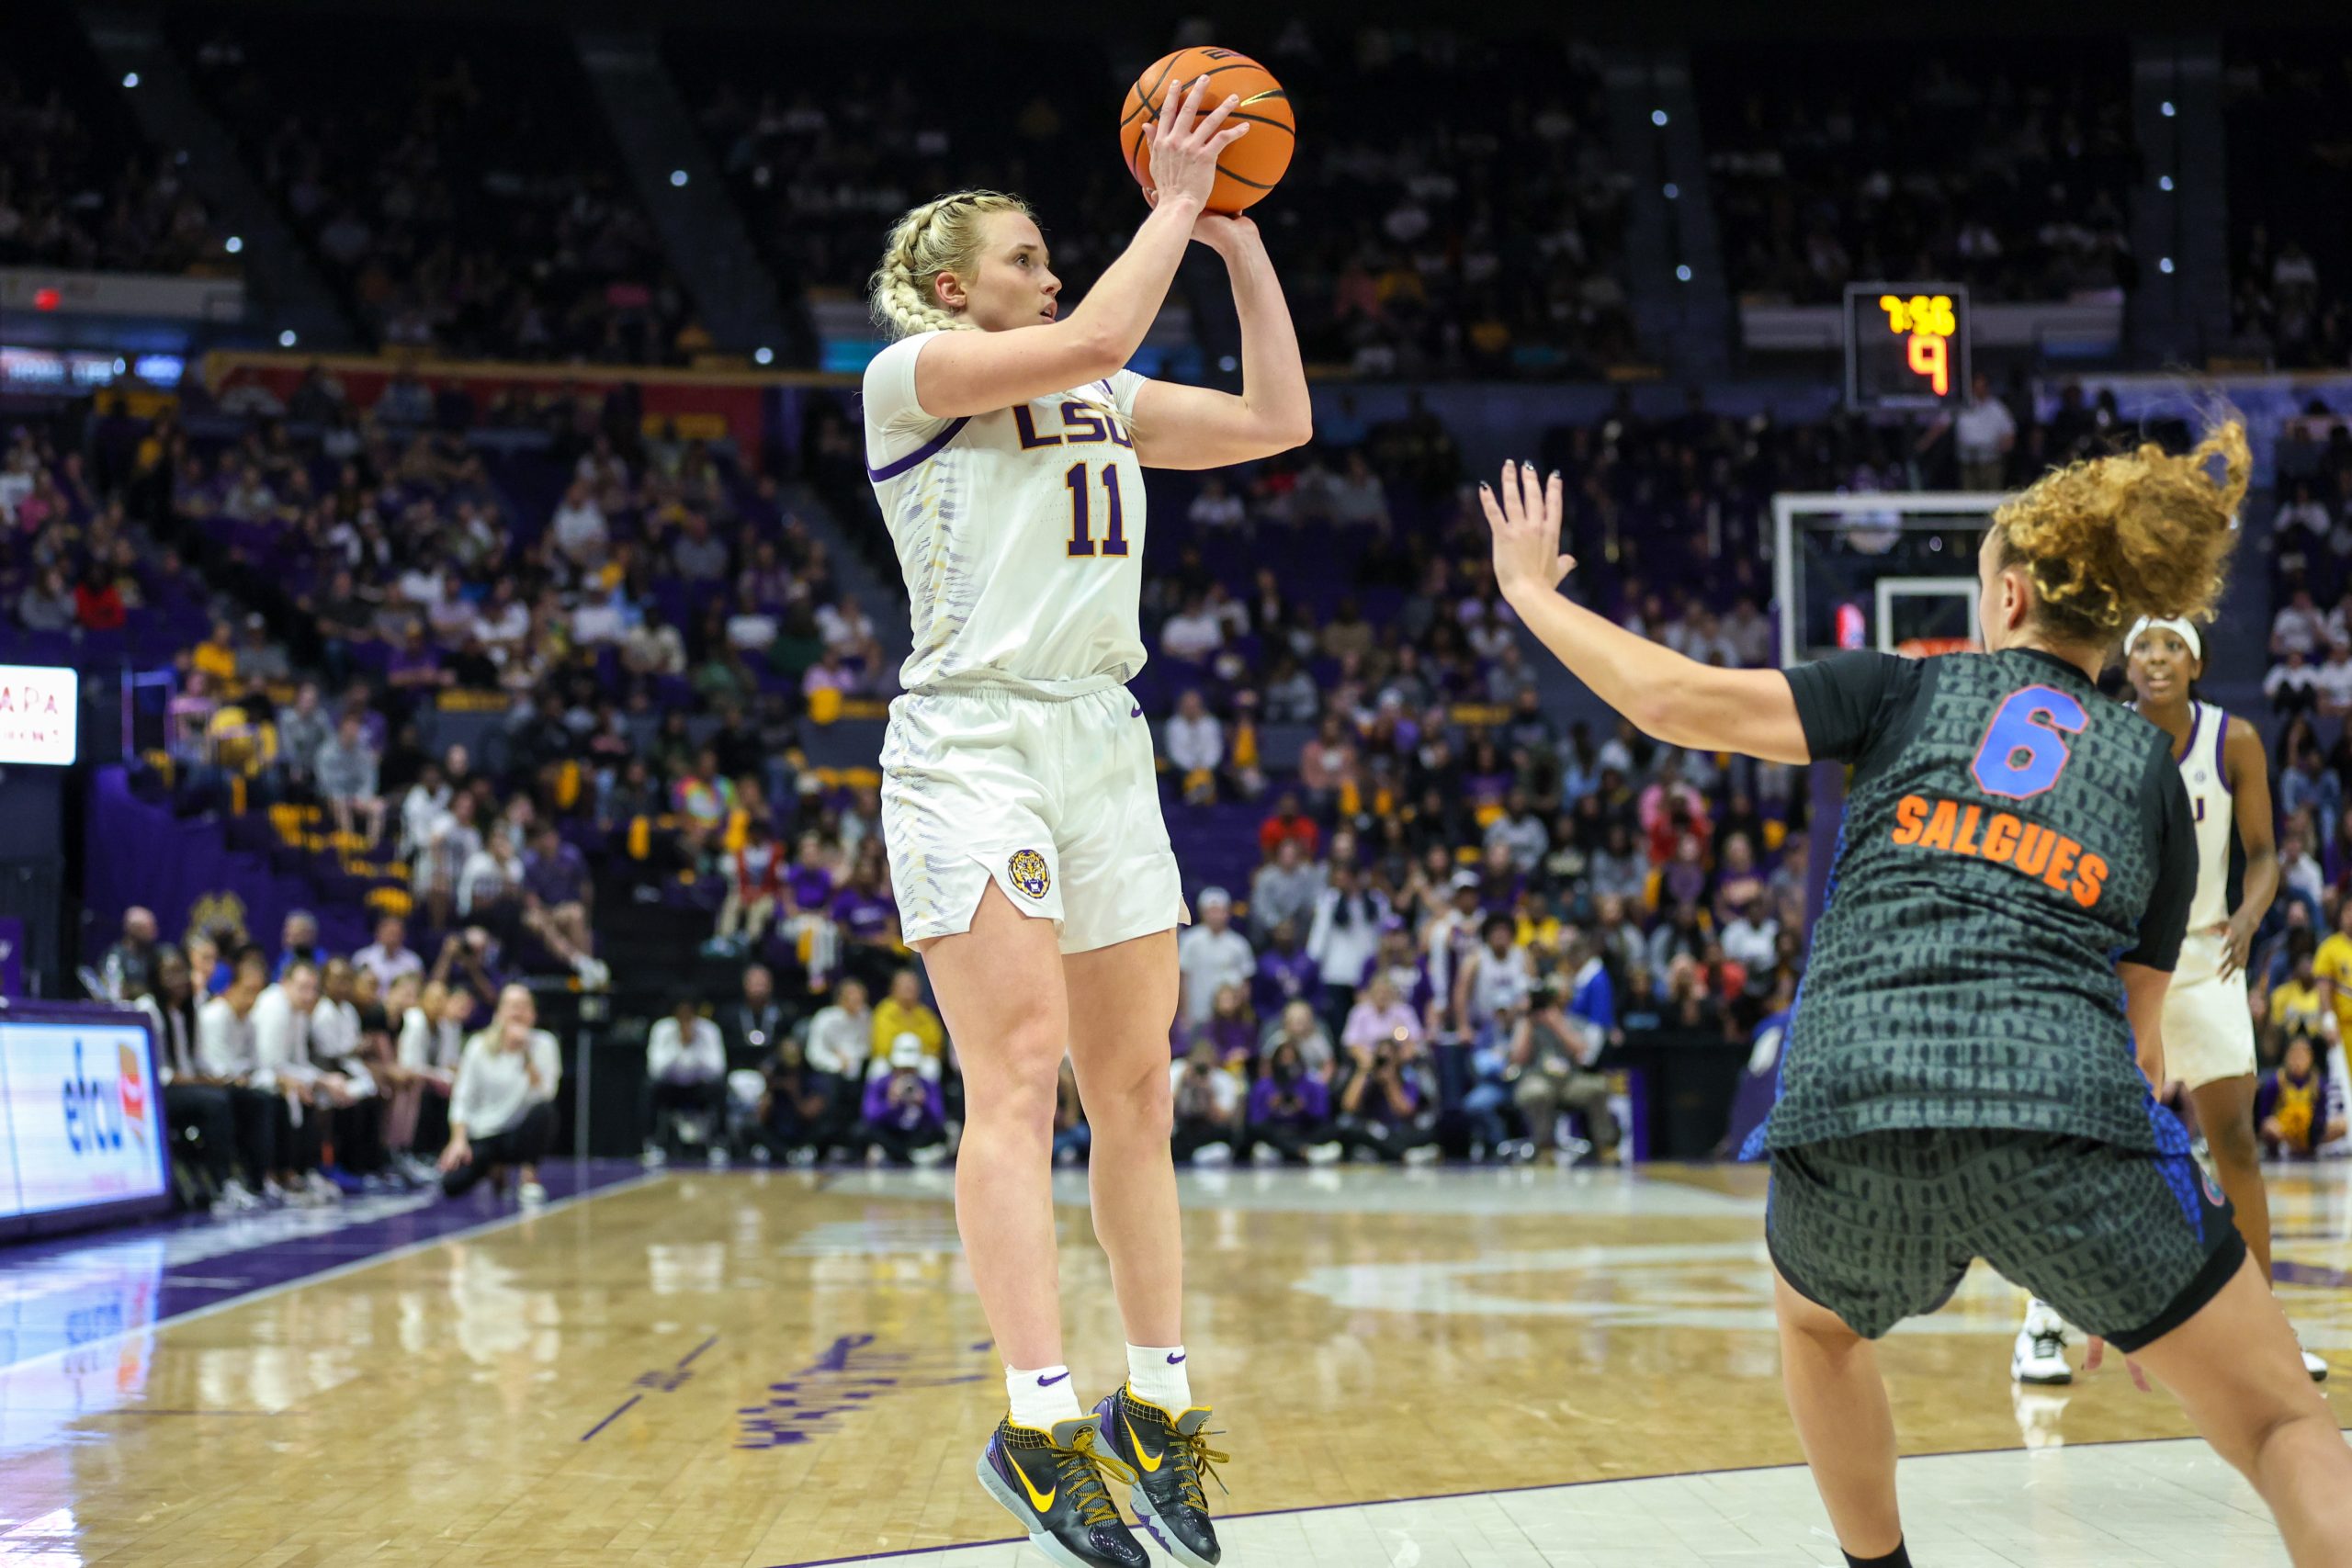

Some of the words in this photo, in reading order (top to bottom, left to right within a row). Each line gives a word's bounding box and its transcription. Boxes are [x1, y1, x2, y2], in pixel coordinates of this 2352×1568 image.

[1908, 334, 1948, 396] 9
[1066, 461, 1129, 558] 11
[1971, 684, 2090, 800] 6
[1892, 795, 2109, 908] SALGUES
